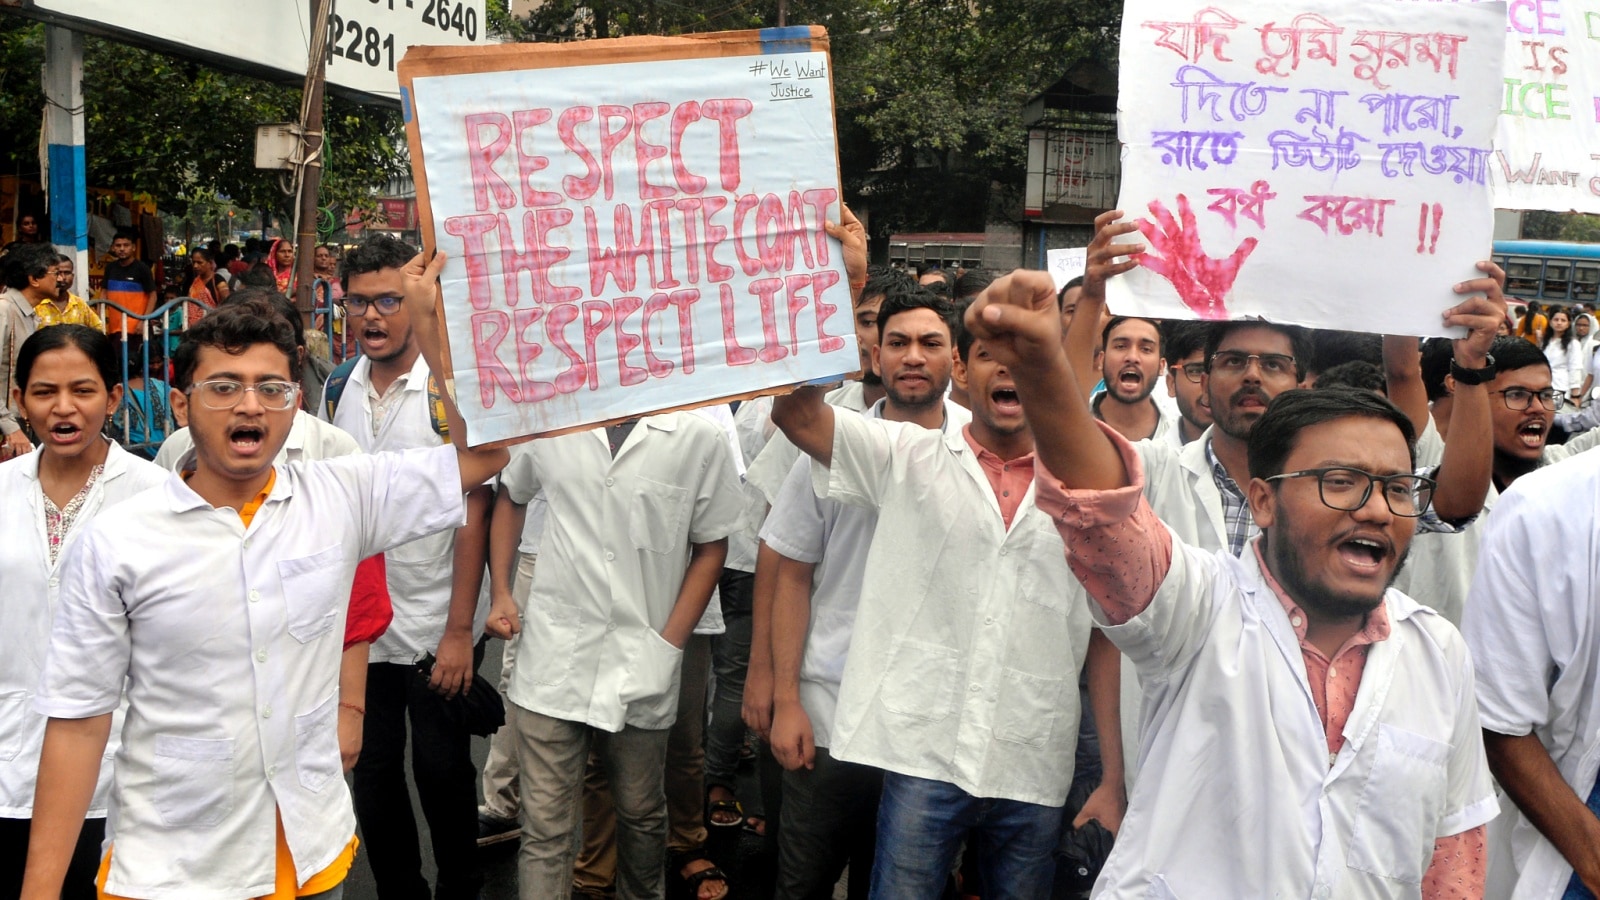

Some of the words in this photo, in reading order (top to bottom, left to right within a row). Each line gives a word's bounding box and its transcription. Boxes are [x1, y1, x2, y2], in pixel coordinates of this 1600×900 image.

[327, 14, 394, 72] 2281
[422, 0, 477, 42] 2640
[1141, 6, 1246, 64] যদি
[1254, 13, 1345, 77] তুমি
[795, 59, 825, 79] Want
[1521, 40, 1568, 75] IS
[770, 82, 813, 100] Justice
[1170, 65, 1289, 123] দিতে
[1295, 89, 1349, 129] না
[1358, 93, 1463, 139] পারো,
[1500, 77, 1571, 120] ICE
[465, 98, 753, 212] RESPECT
[1151, 131, 1245, 171] রাতে
[1268, 126, 1371, 174] ডিউটি
[1378, 142, 1494, 185] দেওয়া
[1296, 194, 1396, 237] করো
[444, 208, 582, 311] THE
[471, 288, 700, 409] RESPECT
[720, 270, 845, 367] LIFE
